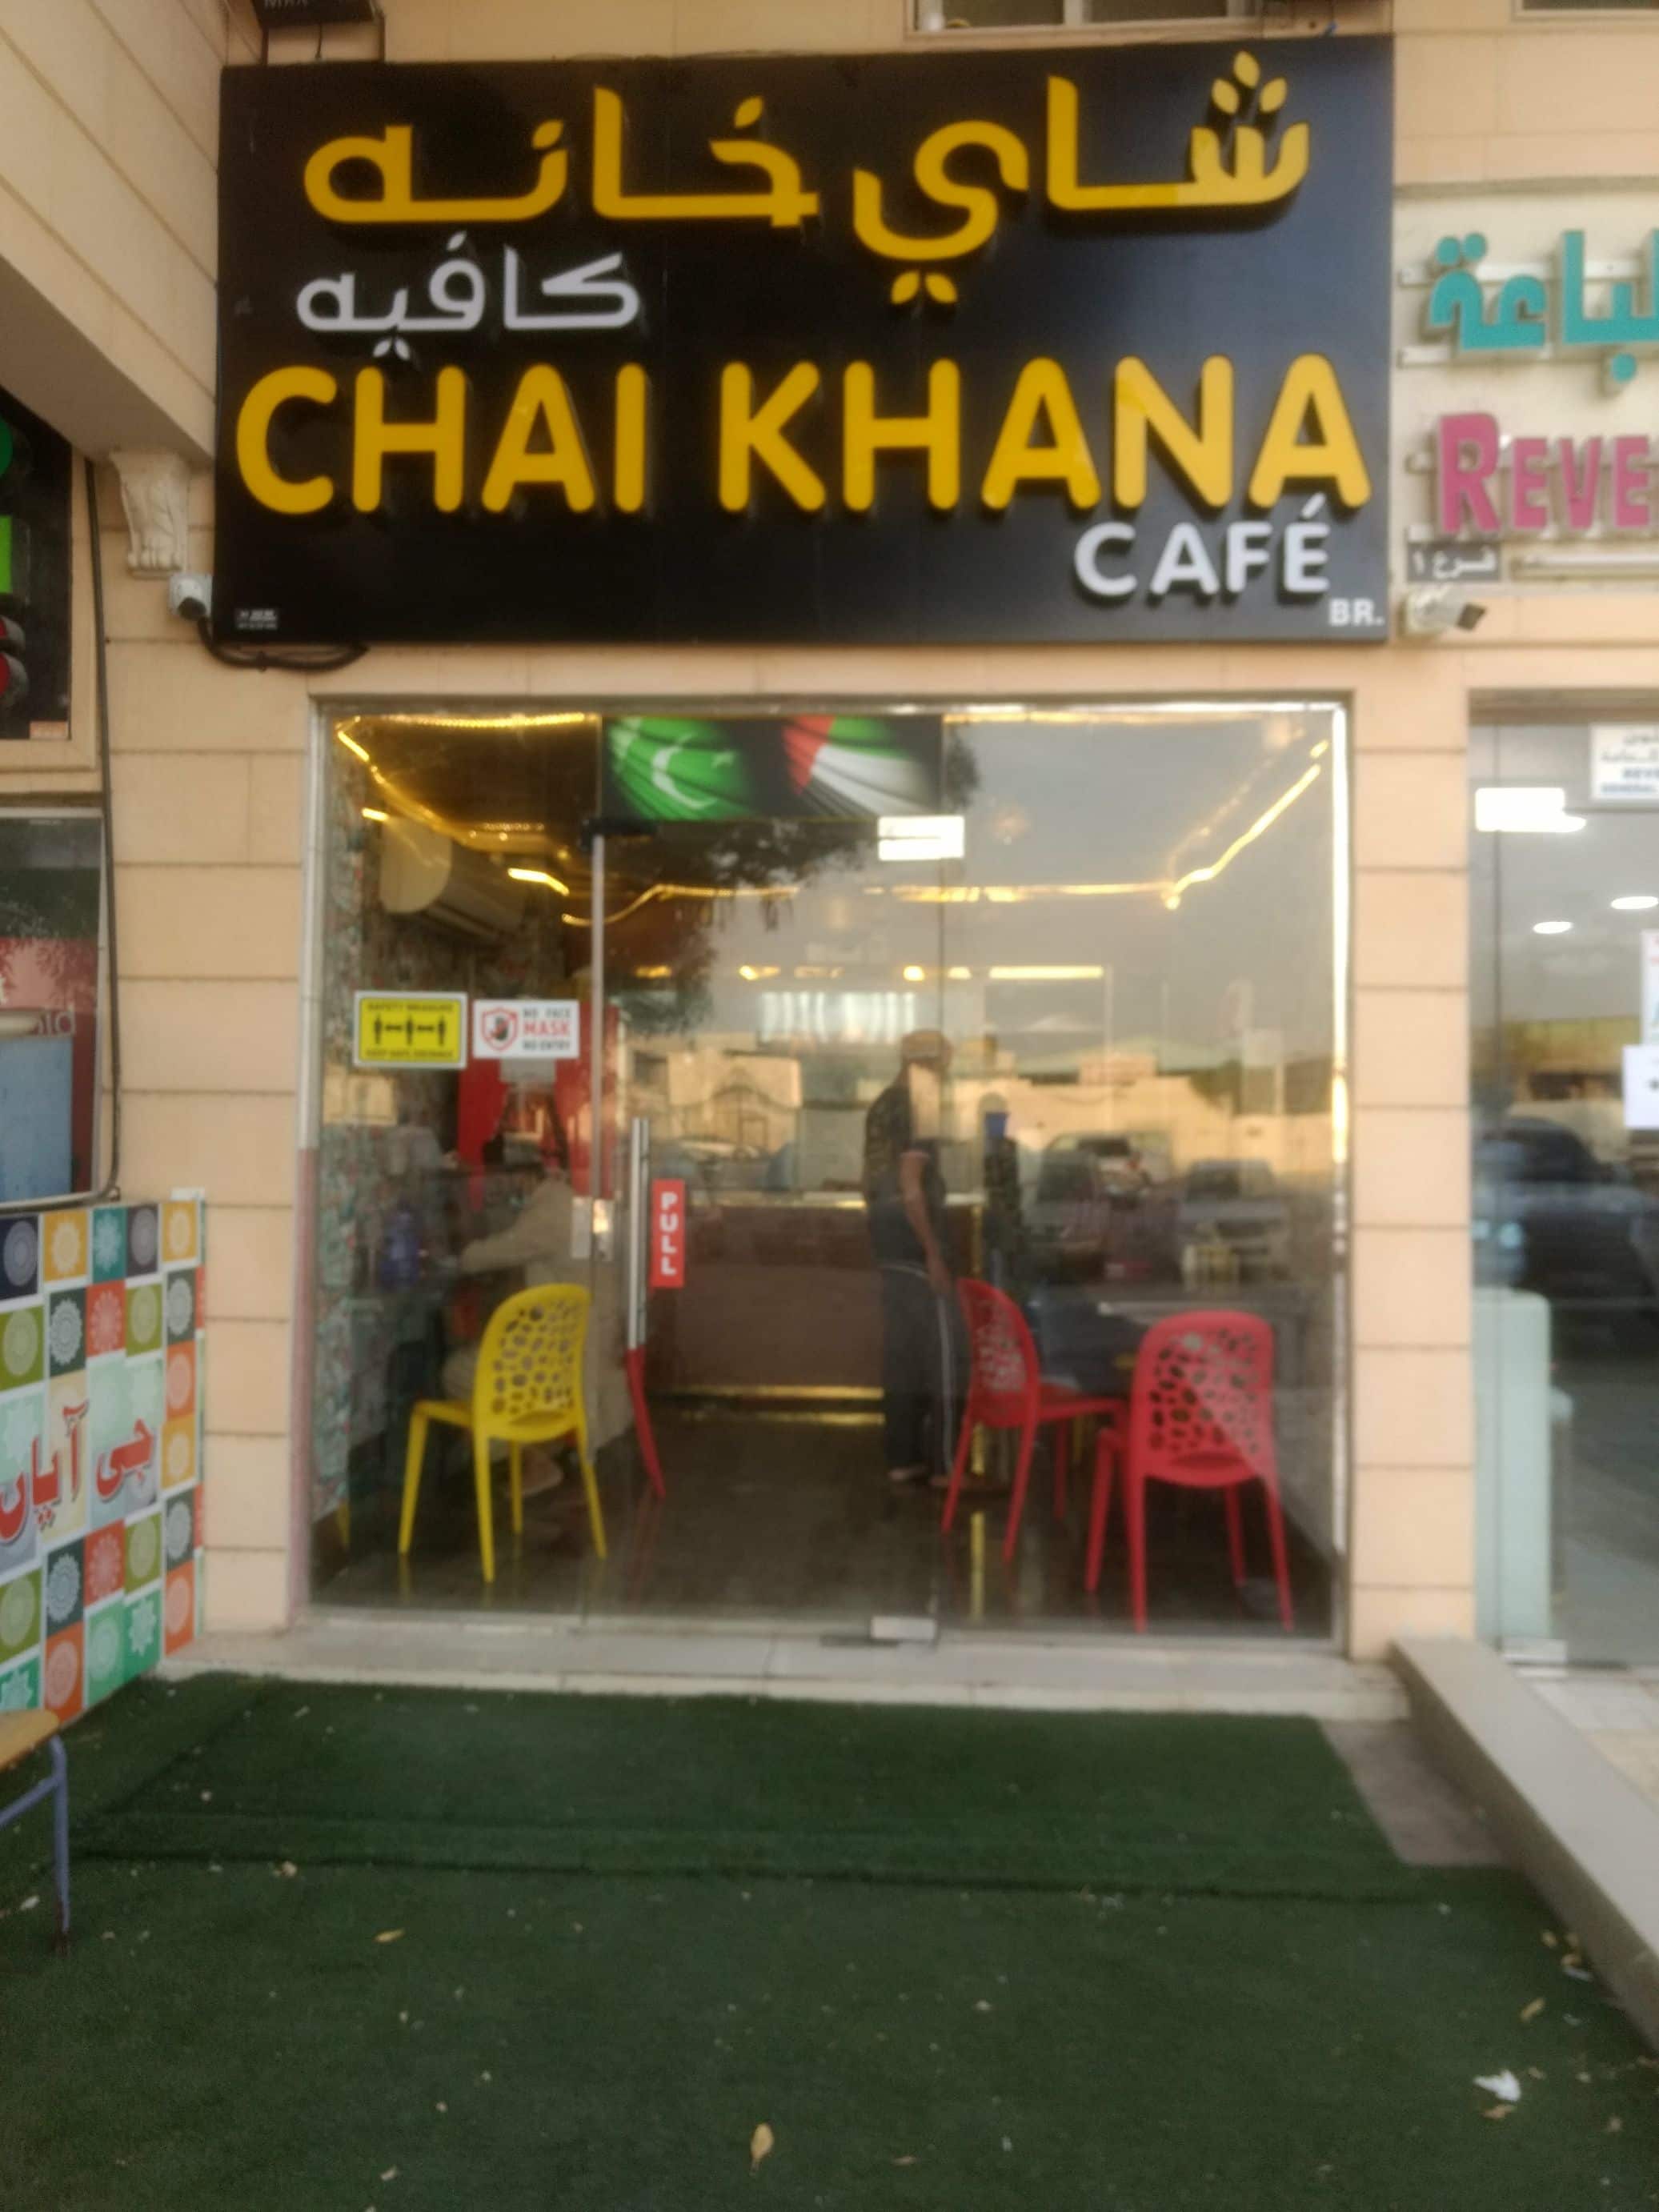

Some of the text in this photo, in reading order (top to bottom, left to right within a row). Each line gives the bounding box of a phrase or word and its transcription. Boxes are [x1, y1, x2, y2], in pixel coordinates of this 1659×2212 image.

[853, 51, 1310, 304] شاي
[296, 231, 639, 360] كافيه
[1429, 229, 1659, 383] باعة
[236, 354, 1372, 515] CHAI KHANA
[1438, 412, 1659, 534] REVE
[1074, 493, 1330, 596] CAFÉ
[1329, 598, 1386, 627] BR.
[523, 1020, 571, 1036] MASK
[660, 1191, 679, 1276] PULL
